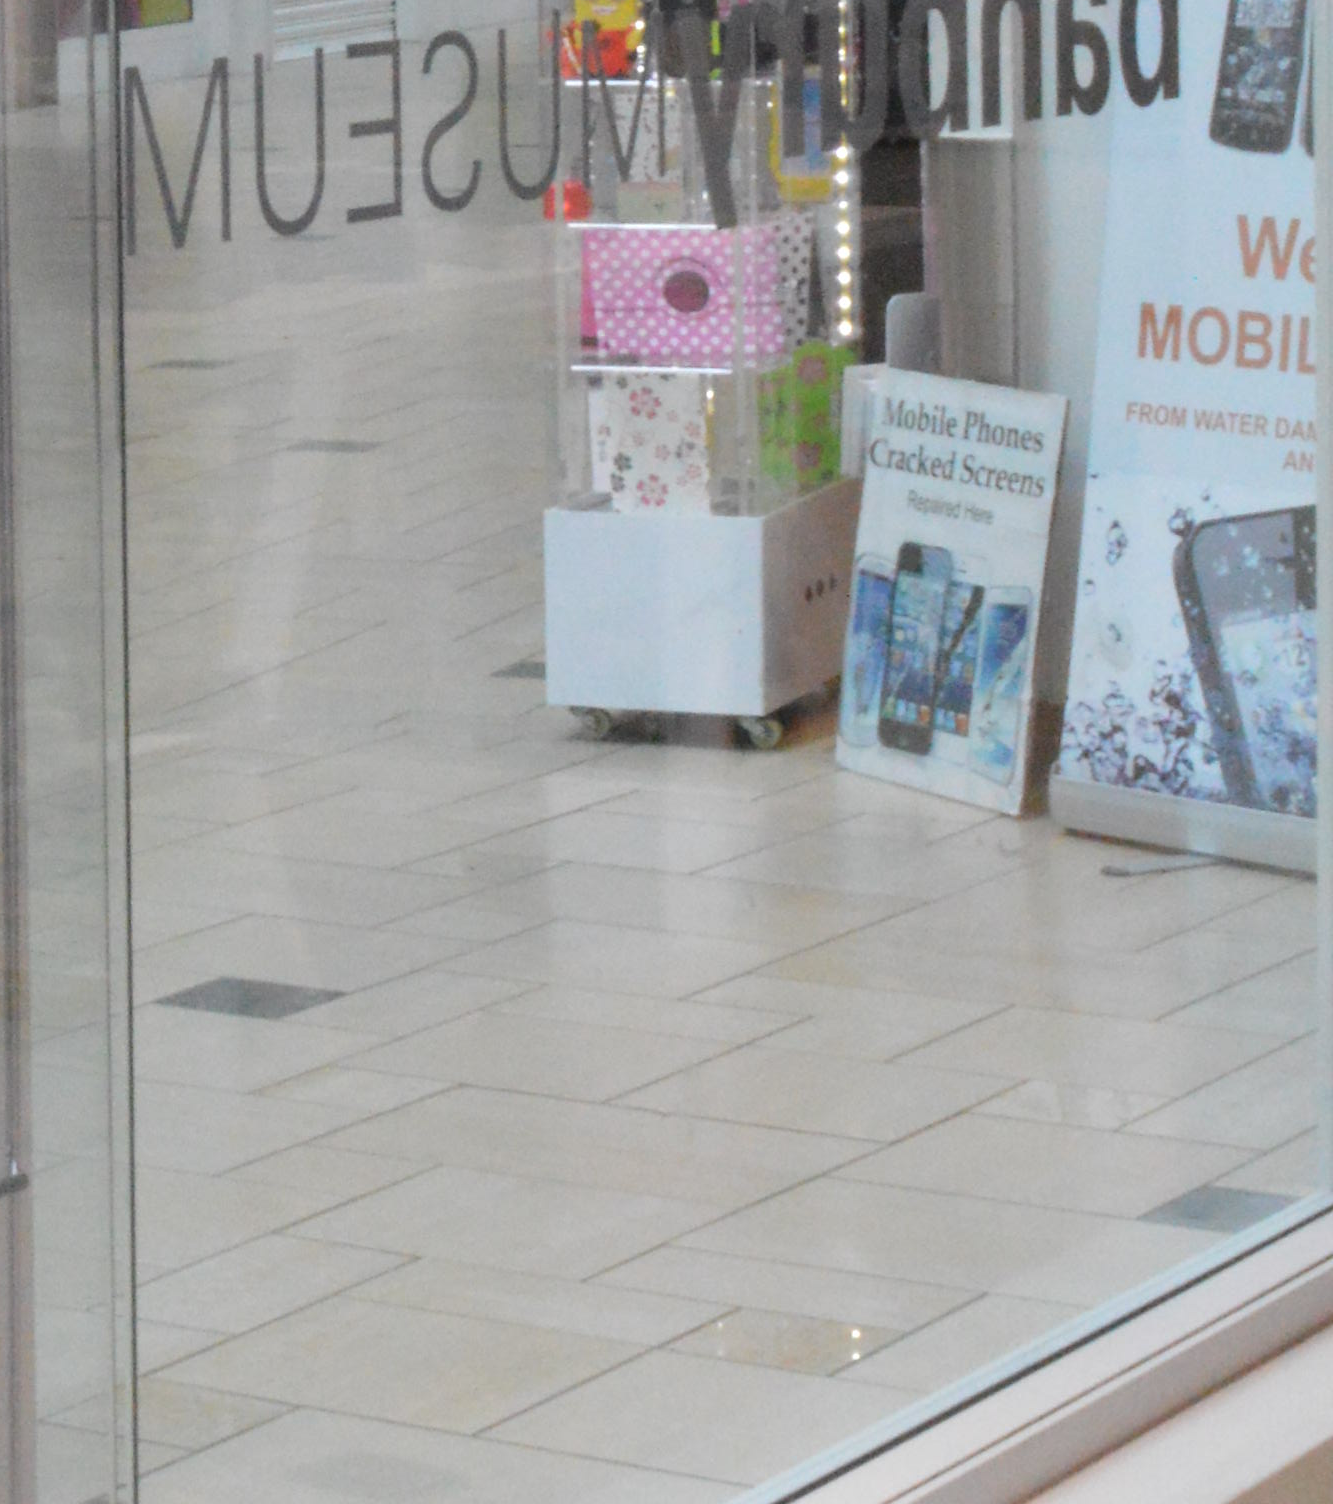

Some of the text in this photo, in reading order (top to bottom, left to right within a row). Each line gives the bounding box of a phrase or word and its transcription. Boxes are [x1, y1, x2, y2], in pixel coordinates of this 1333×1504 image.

[882, 397, 1046, 454] Mobile Phones
[1125, 401, 1187, 430] FROM
[1193, 408, 1269, 438] WATER
[869, 437, 1045, 498] Cracked Screens
[906, 489, 995, 526] Repaired Here
